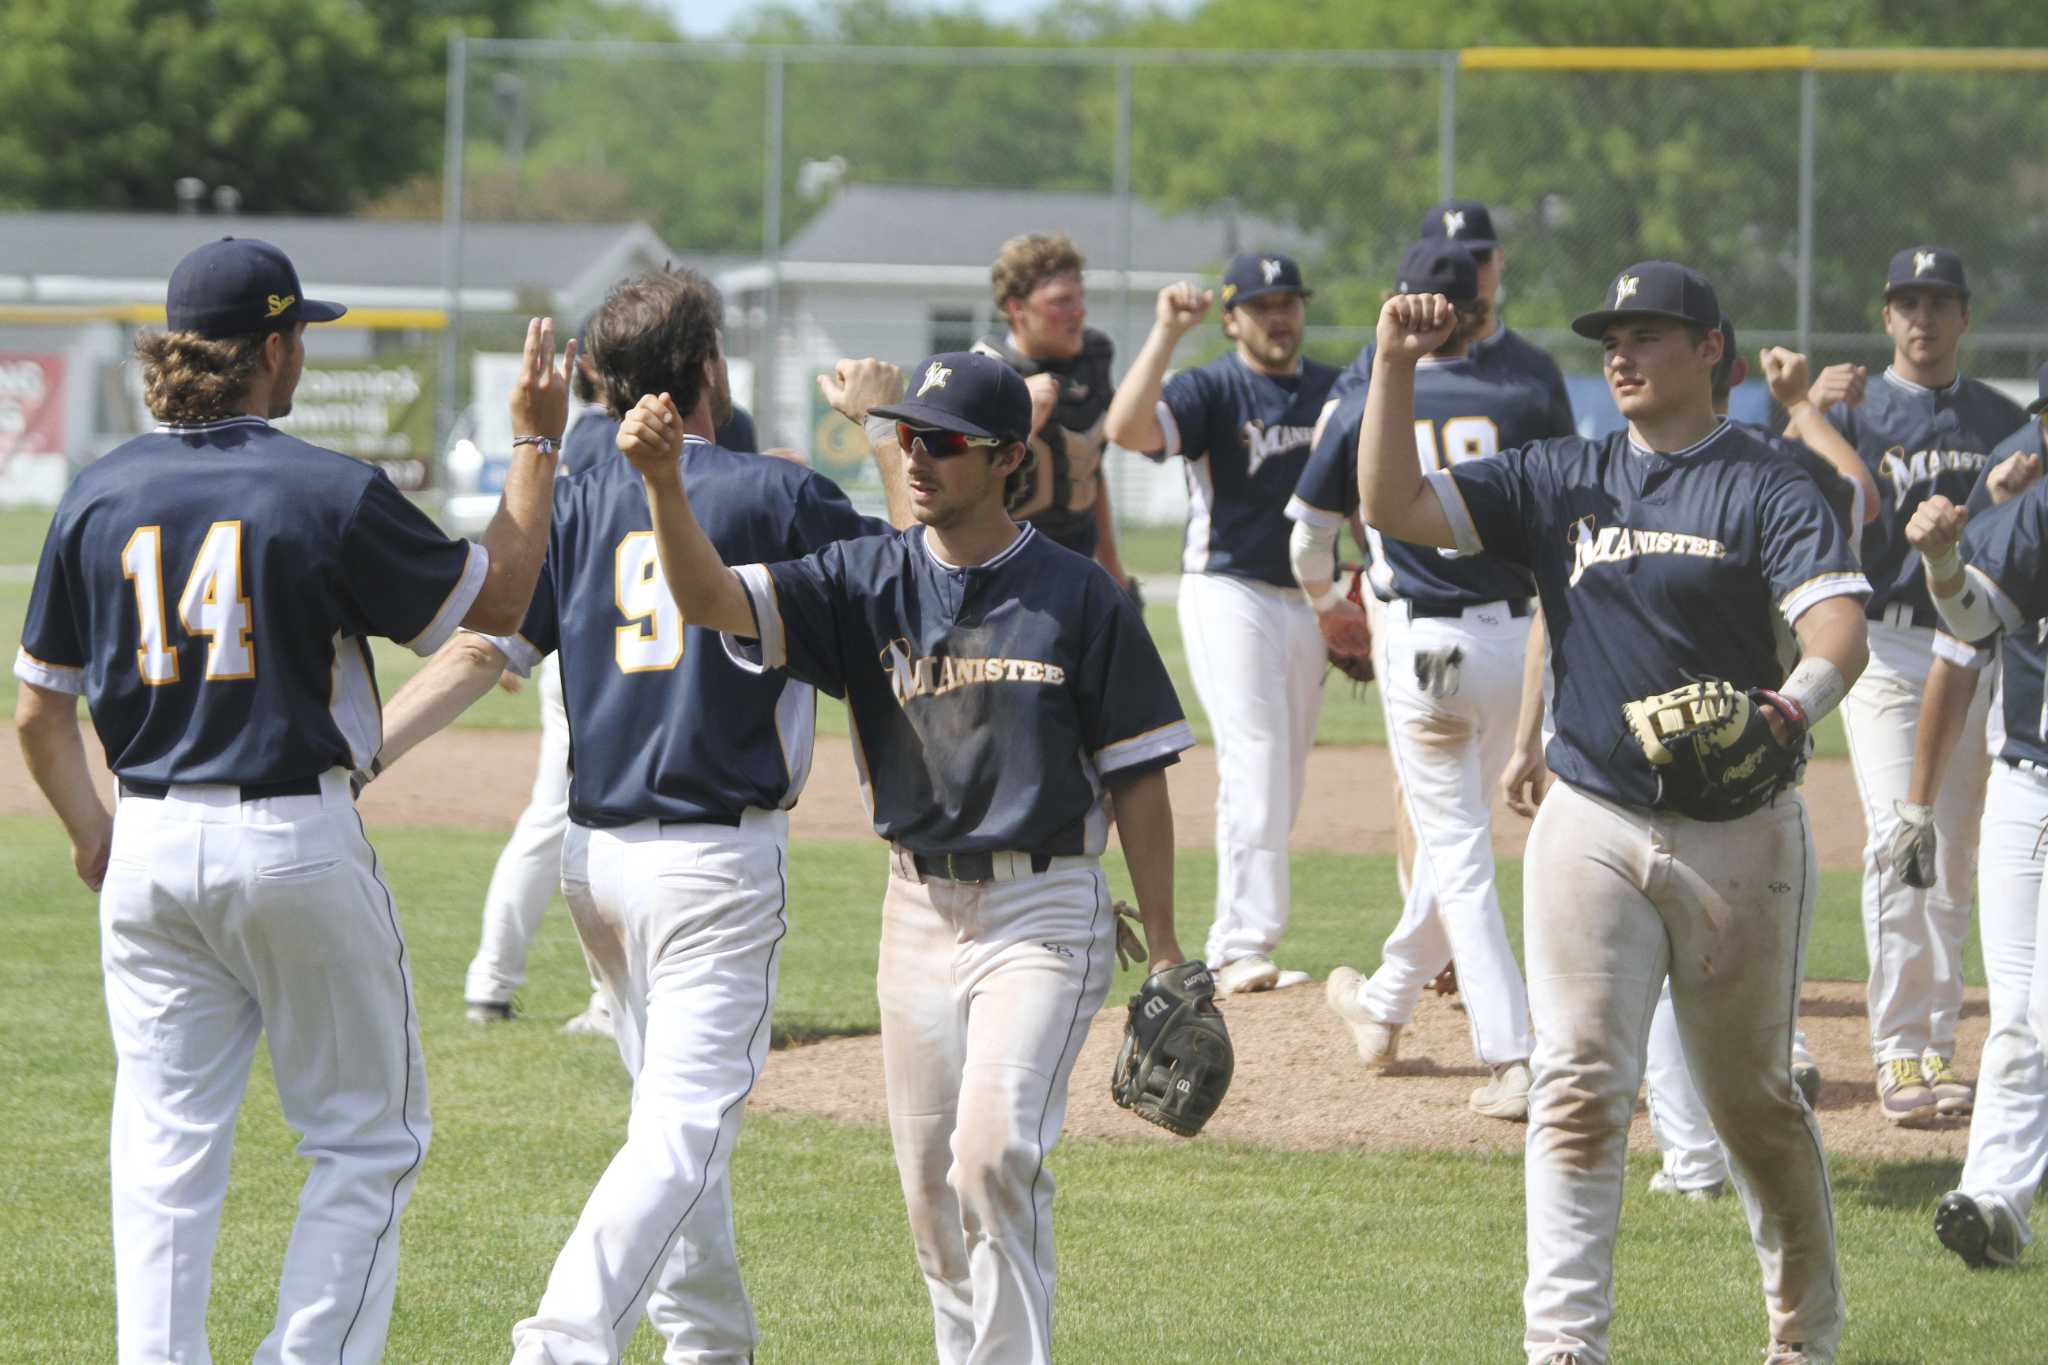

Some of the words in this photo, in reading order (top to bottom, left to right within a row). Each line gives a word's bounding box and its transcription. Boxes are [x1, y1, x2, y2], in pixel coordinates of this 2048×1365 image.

[1879, 446, 1990, 512] MANIST
[1568, 514, 1727, 588] MANISTEE
[121, 520, 256, 686] 14
[614, 530, 684, 674] 9
[880, 636, 1065, 707] MANISTEE
